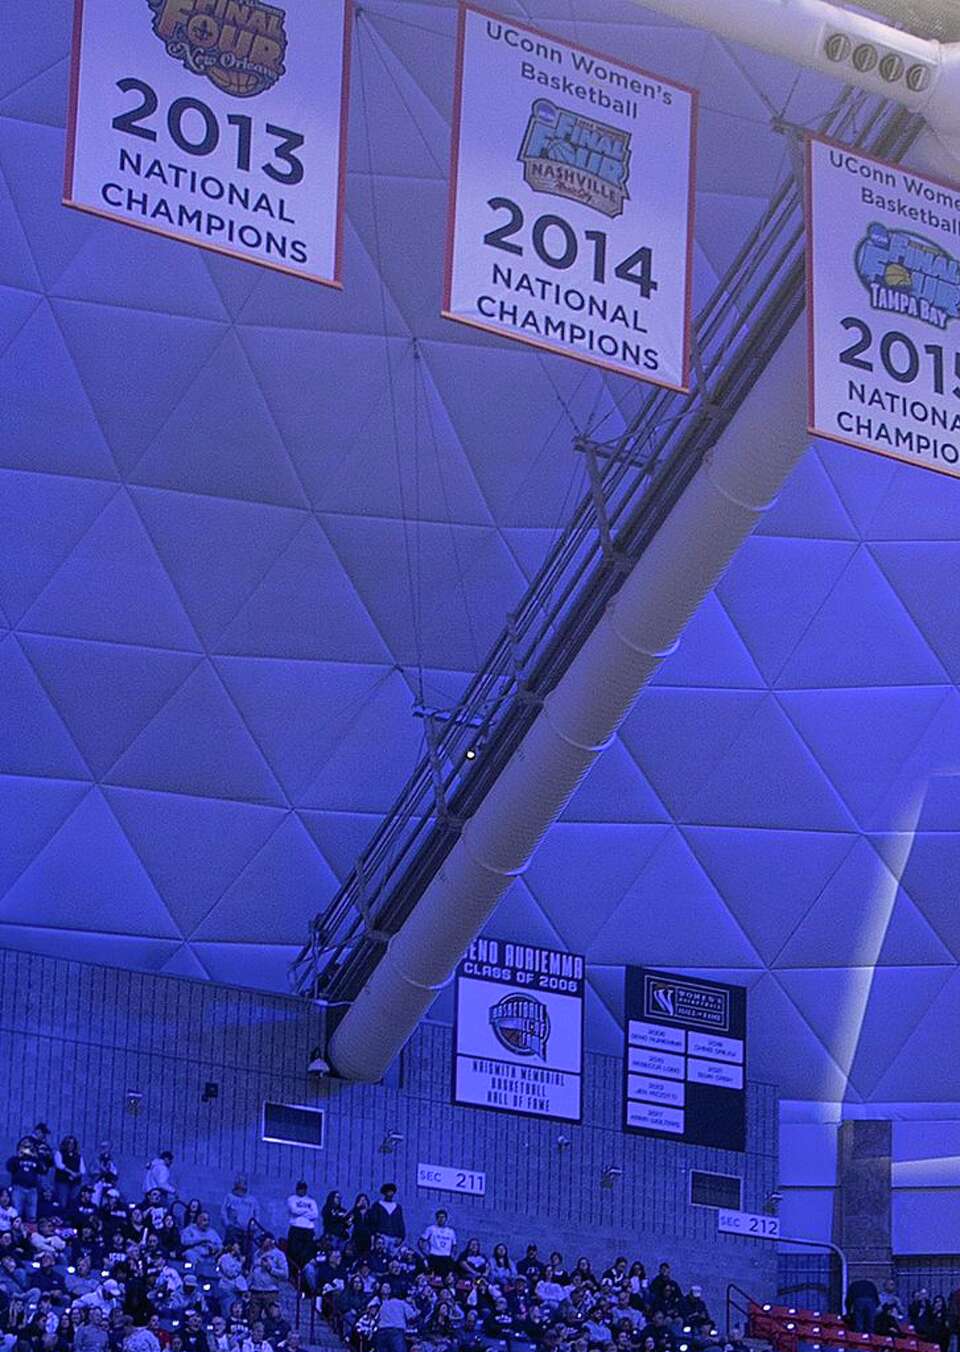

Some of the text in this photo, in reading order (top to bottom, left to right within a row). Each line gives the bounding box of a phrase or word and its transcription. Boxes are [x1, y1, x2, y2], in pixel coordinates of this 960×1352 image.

[158, 1, 285, 66] FOUR
[486, 21, 673, 106] UConn Women's
[521, 61, 638, 119] Basketball
[111, 77, 305, 186] 2013
[118, 147, 296, 225] NATIONAL
[531, 162, 617, 201] NASHVILLE
[829, 150, 896, 188] UConn
[101, 182, 308, 264] CHAMPIONS
[483, 196, 658, 300] 2014
[492, 263, 647, 334] NATIONAL
[870, 283, 948, 328] TAMPA BAY
[477, 295, 659, 370] CHAMPIONS
[463, 961, 512, 980] CLASS
[516, 971, 534, 984] OF
[505, 943, 583, 980] AURIEMMA
[420, 1169, 483, 1191] SEC 211
[720, 1215, 777, 1235] SEC 212
